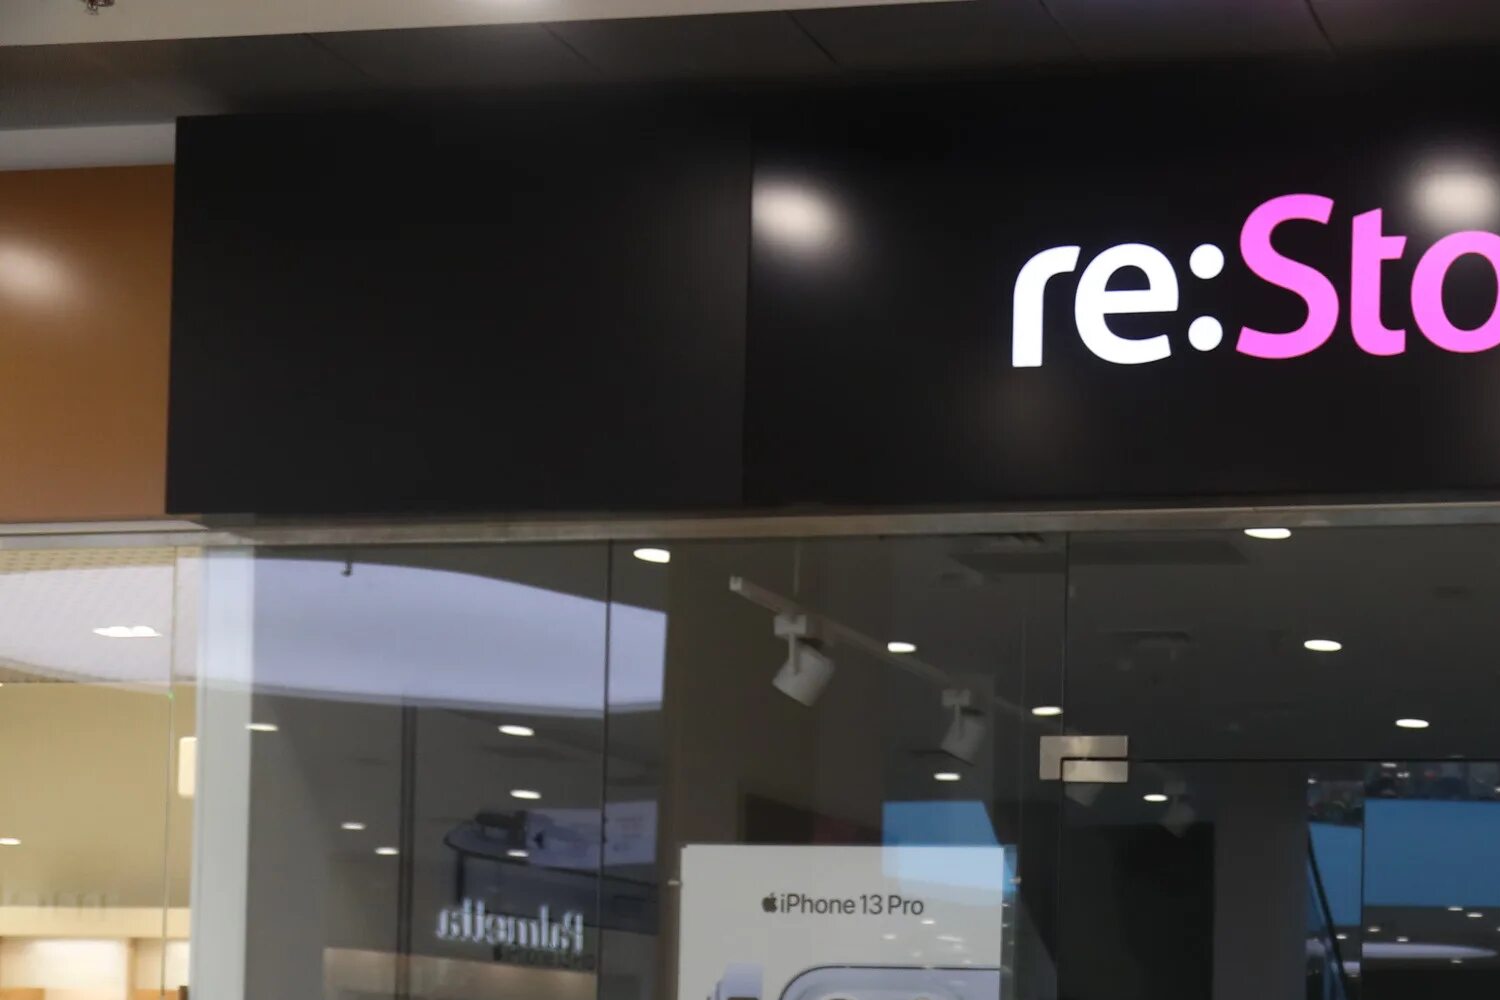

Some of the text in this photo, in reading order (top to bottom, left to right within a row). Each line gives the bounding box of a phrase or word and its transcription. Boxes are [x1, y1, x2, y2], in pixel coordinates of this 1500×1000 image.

[780, 893, 925, 915] iPhone 13 Pro
